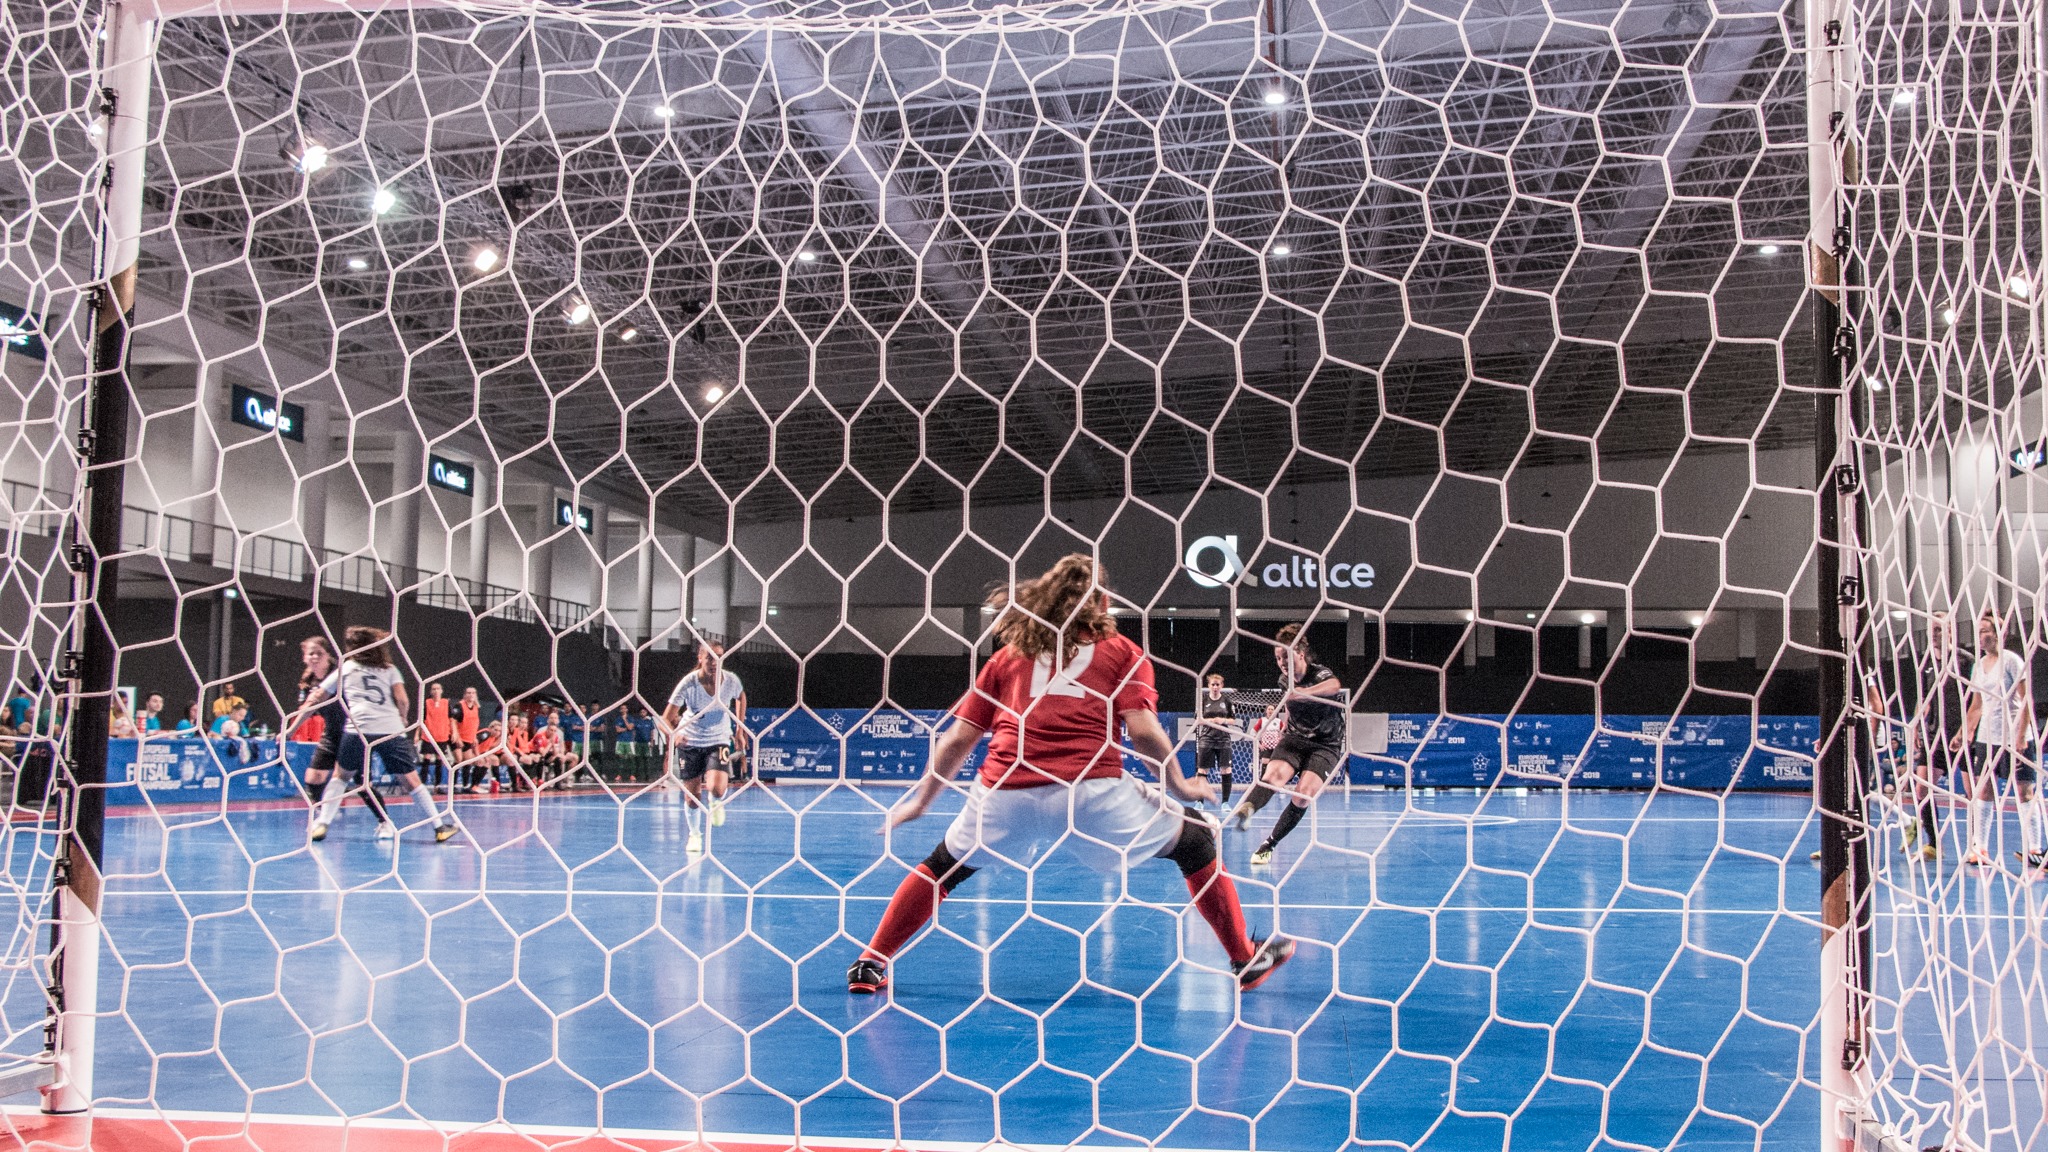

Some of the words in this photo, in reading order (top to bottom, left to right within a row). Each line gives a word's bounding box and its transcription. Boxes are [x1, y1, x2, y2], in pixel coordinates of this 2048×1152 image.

[1262, 555, 1376, 588] altce
[1029, 643, 1096, 699] 12
[361, 675, 386, 706] 5
[861, 724, 903, 734] FUTSAL
[1388, 730, 1415, 739] TSAL
[1763, 766, 1806, 776] FUTSAL
